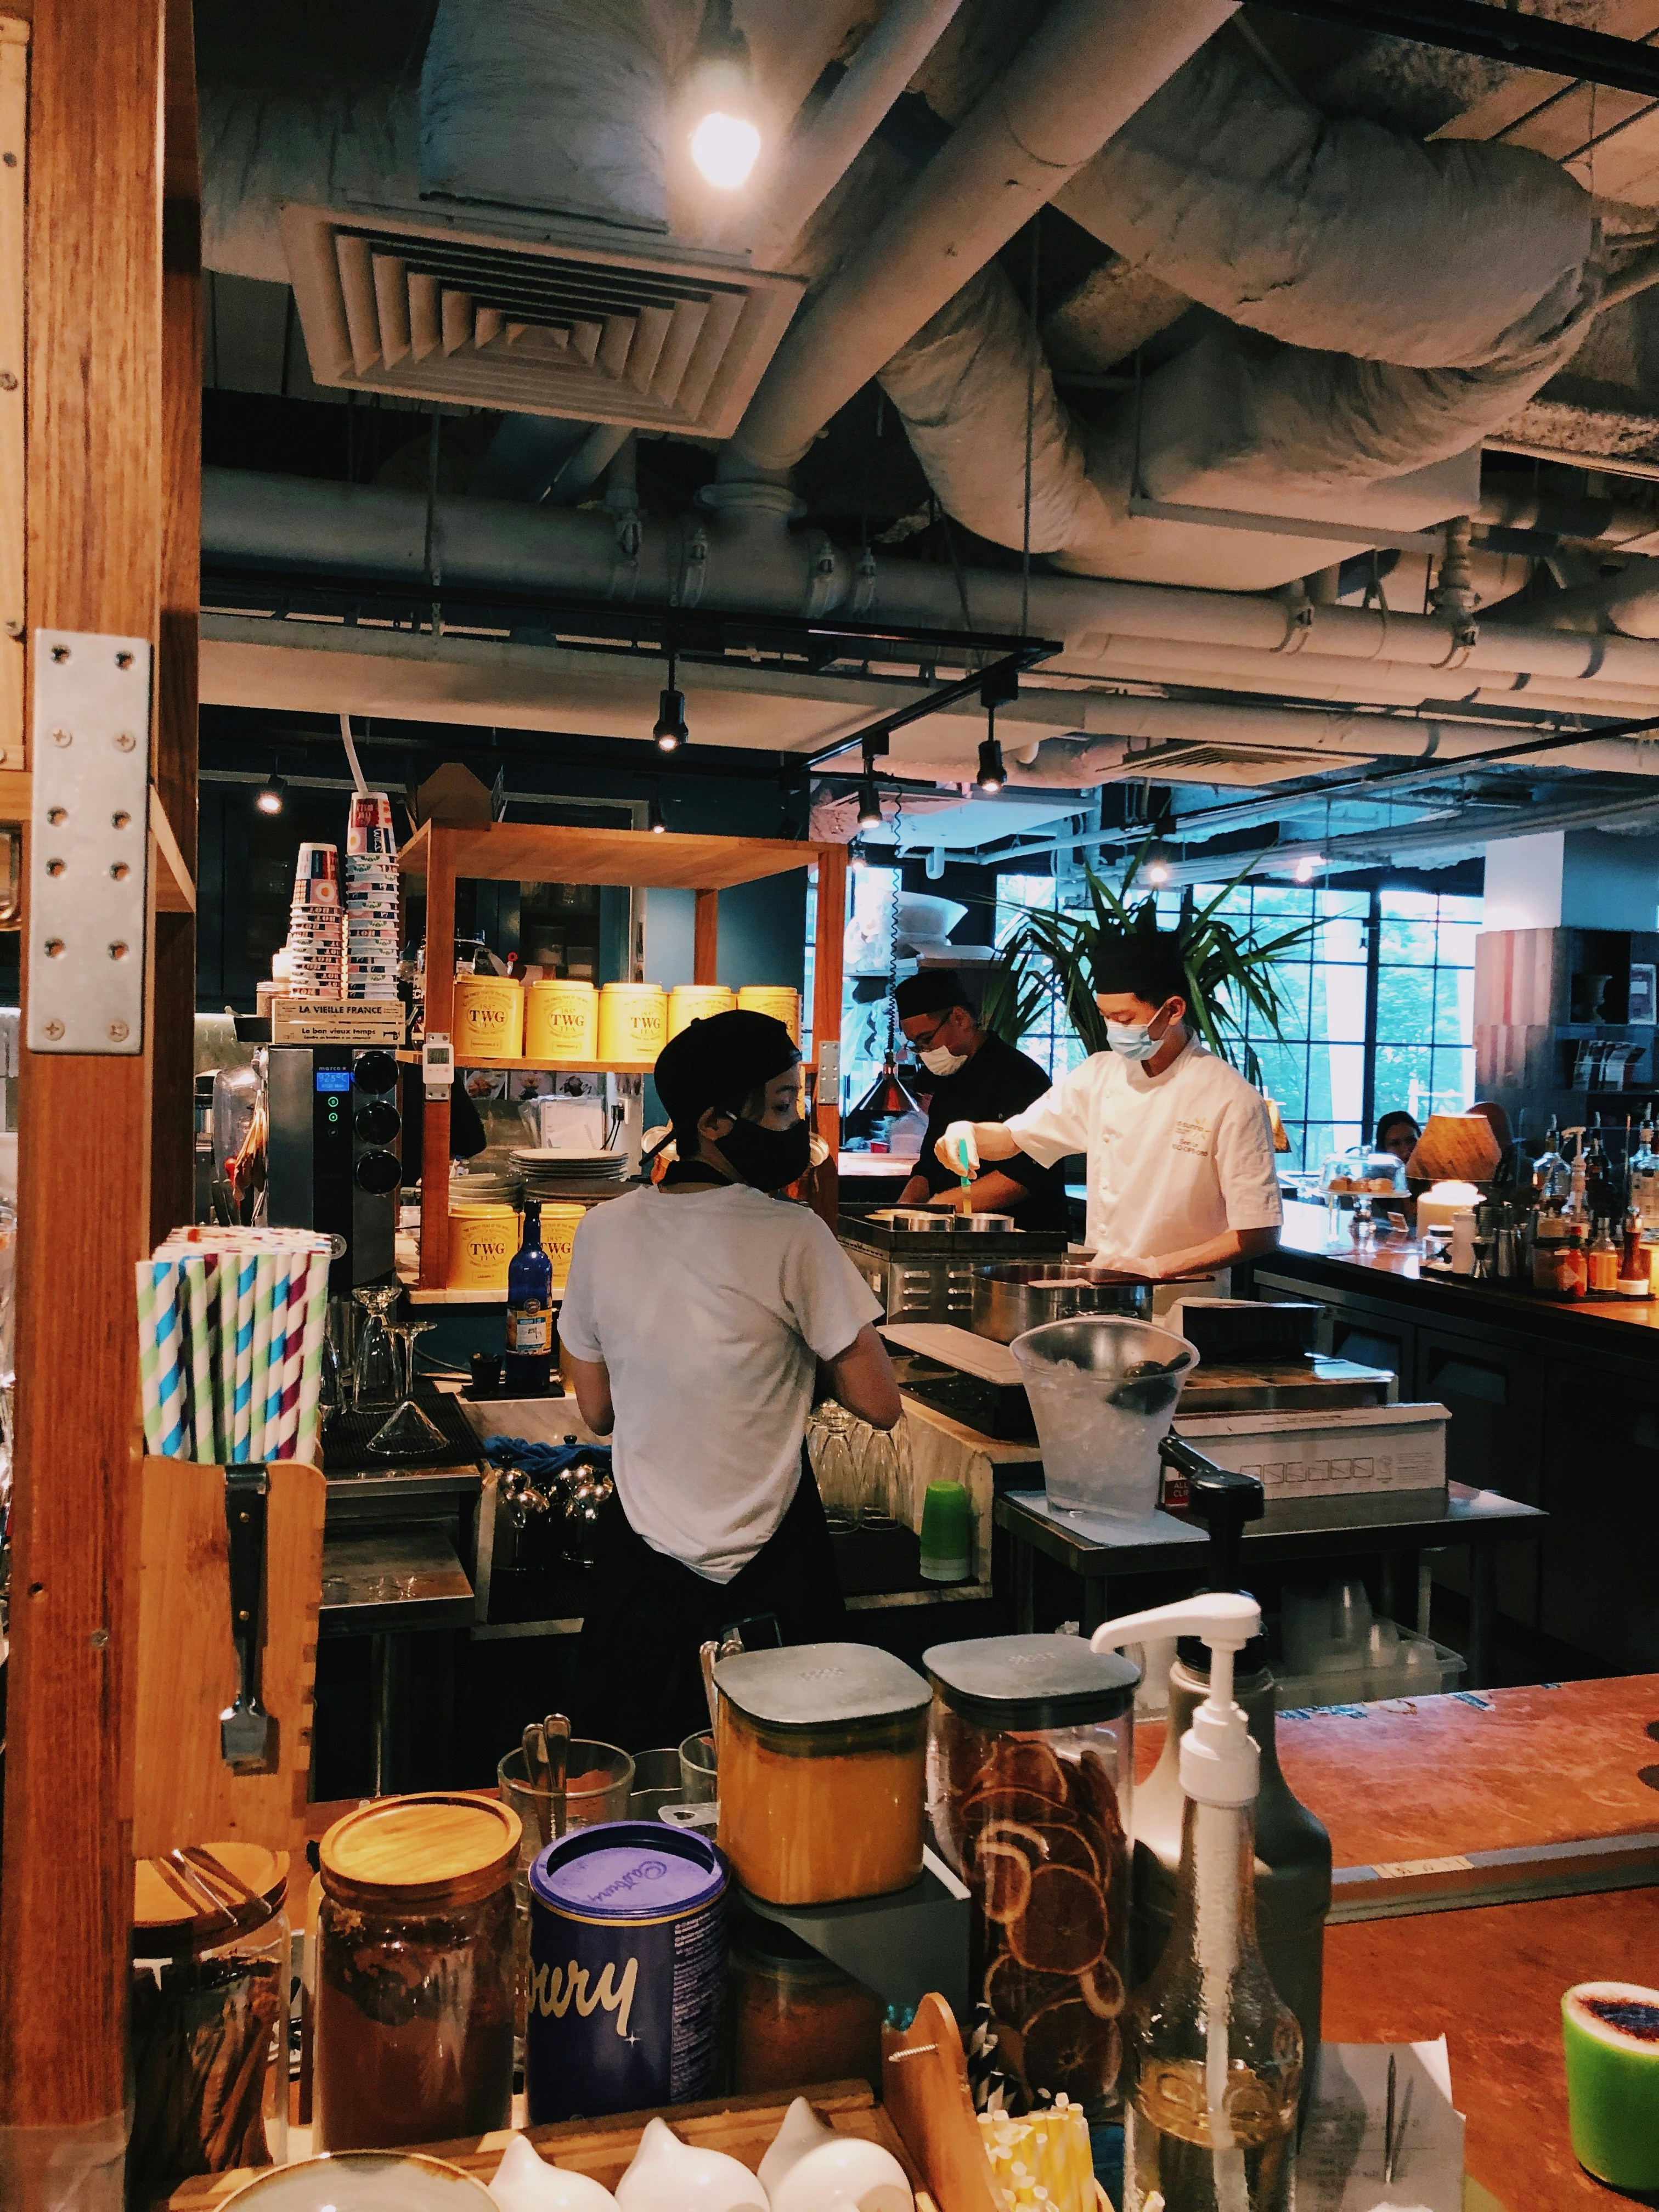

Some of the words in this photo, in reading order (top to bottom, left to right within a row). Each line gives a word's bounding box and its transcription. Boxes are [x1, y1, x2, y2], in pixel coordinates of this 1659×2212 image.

[313, 1006, 344, 1014] VIEILLE
[347, 1006, 382, 1014] FRANCE
[469, 1009, 505, 1023] TWG
[550, 1014, 584, 1026] TWG
[630, 1017, 661, 1029] TWG
[470, 1243, 505, 1255] TWG
[527, 1957, 638, 2037] ury
